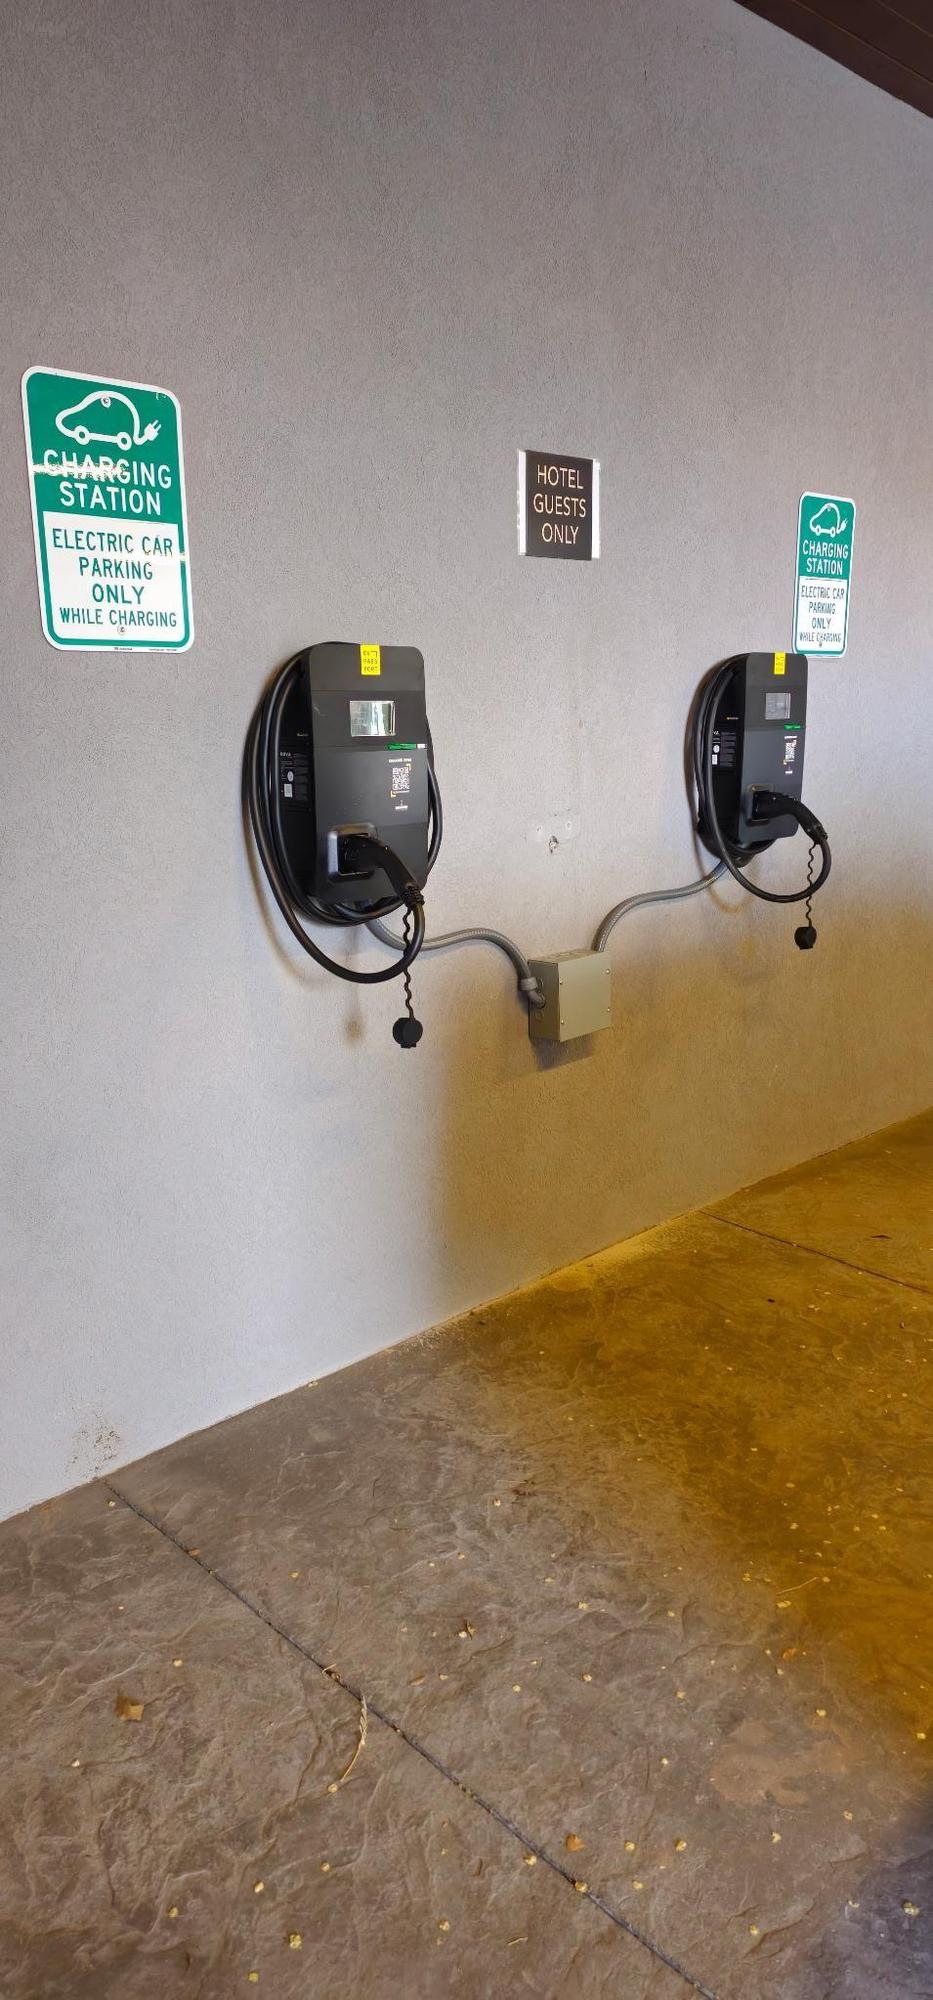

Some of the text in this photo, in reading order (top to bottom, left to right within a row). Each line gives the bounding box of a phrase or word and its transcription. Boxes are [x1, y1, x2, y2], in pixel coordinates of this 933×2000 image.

[43, 449, 172, 489] CHARGING
[537, 464, 584, 489] HOTEL
[59, 481, 161, 516] STATION
[533, 493, 586, 518] GUESTS
[52, 528, 174, 557] ELECTRIC CAR
[541, 522, 579, 545] ONLY
[802, 539, 849, 559] CHARGING
[79, 556, 153, 580] PARKING
[806, 557, 843, 576] STATION
[92, 583, 145, 605] ONLY
[801, 585, 845, 600] ELECTRIC CAR
[59, 607, 177, 627] WHILE CHARGING
[808, 601, 836, 615] PARKING
[811, 617, 832, 630] ONLY
[799, 631, 842, 643] WHILE CHARGING
